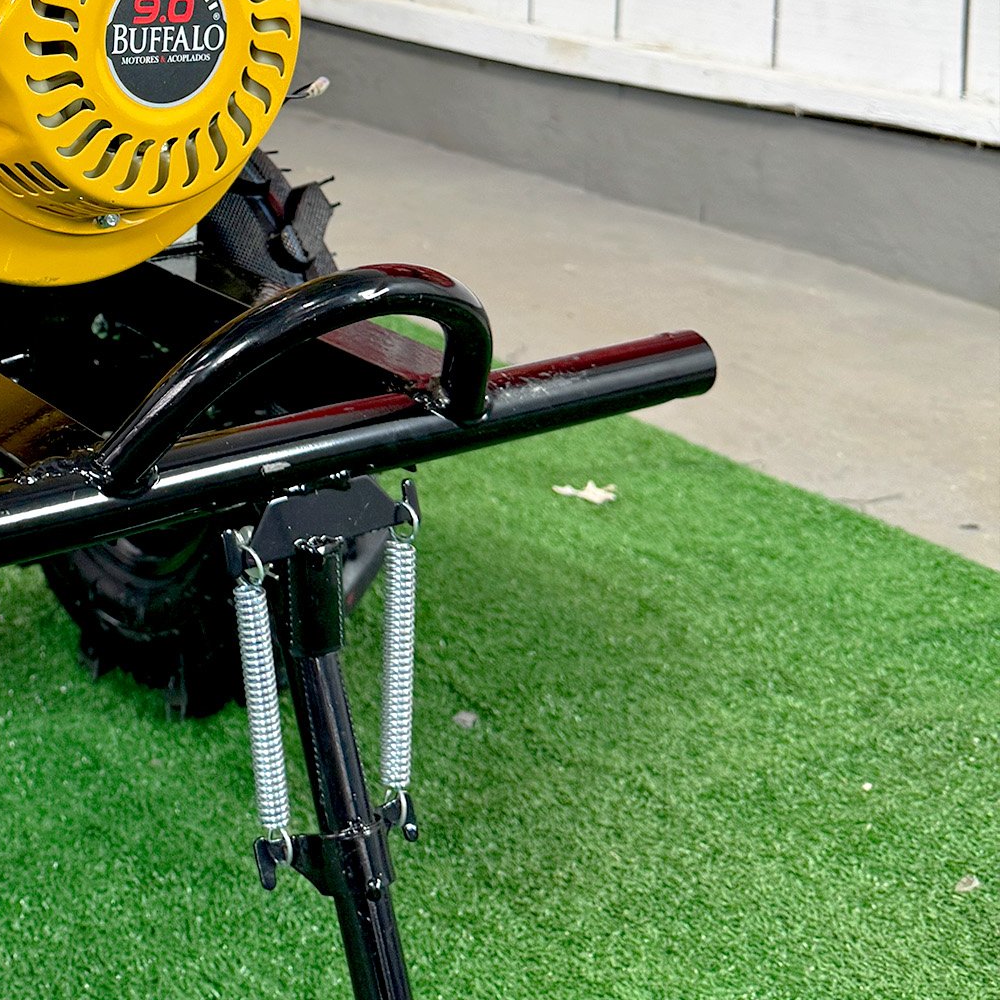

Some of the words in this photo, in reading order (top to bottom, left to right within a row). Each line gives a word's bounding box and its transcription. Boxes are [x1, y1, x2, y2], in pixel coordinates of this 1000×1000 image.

[111, 24, 225, 55] BUFFALO
[121, 55, 159, 65] MOTORES
[167, 53, 211, 63] ACOPLADOS
